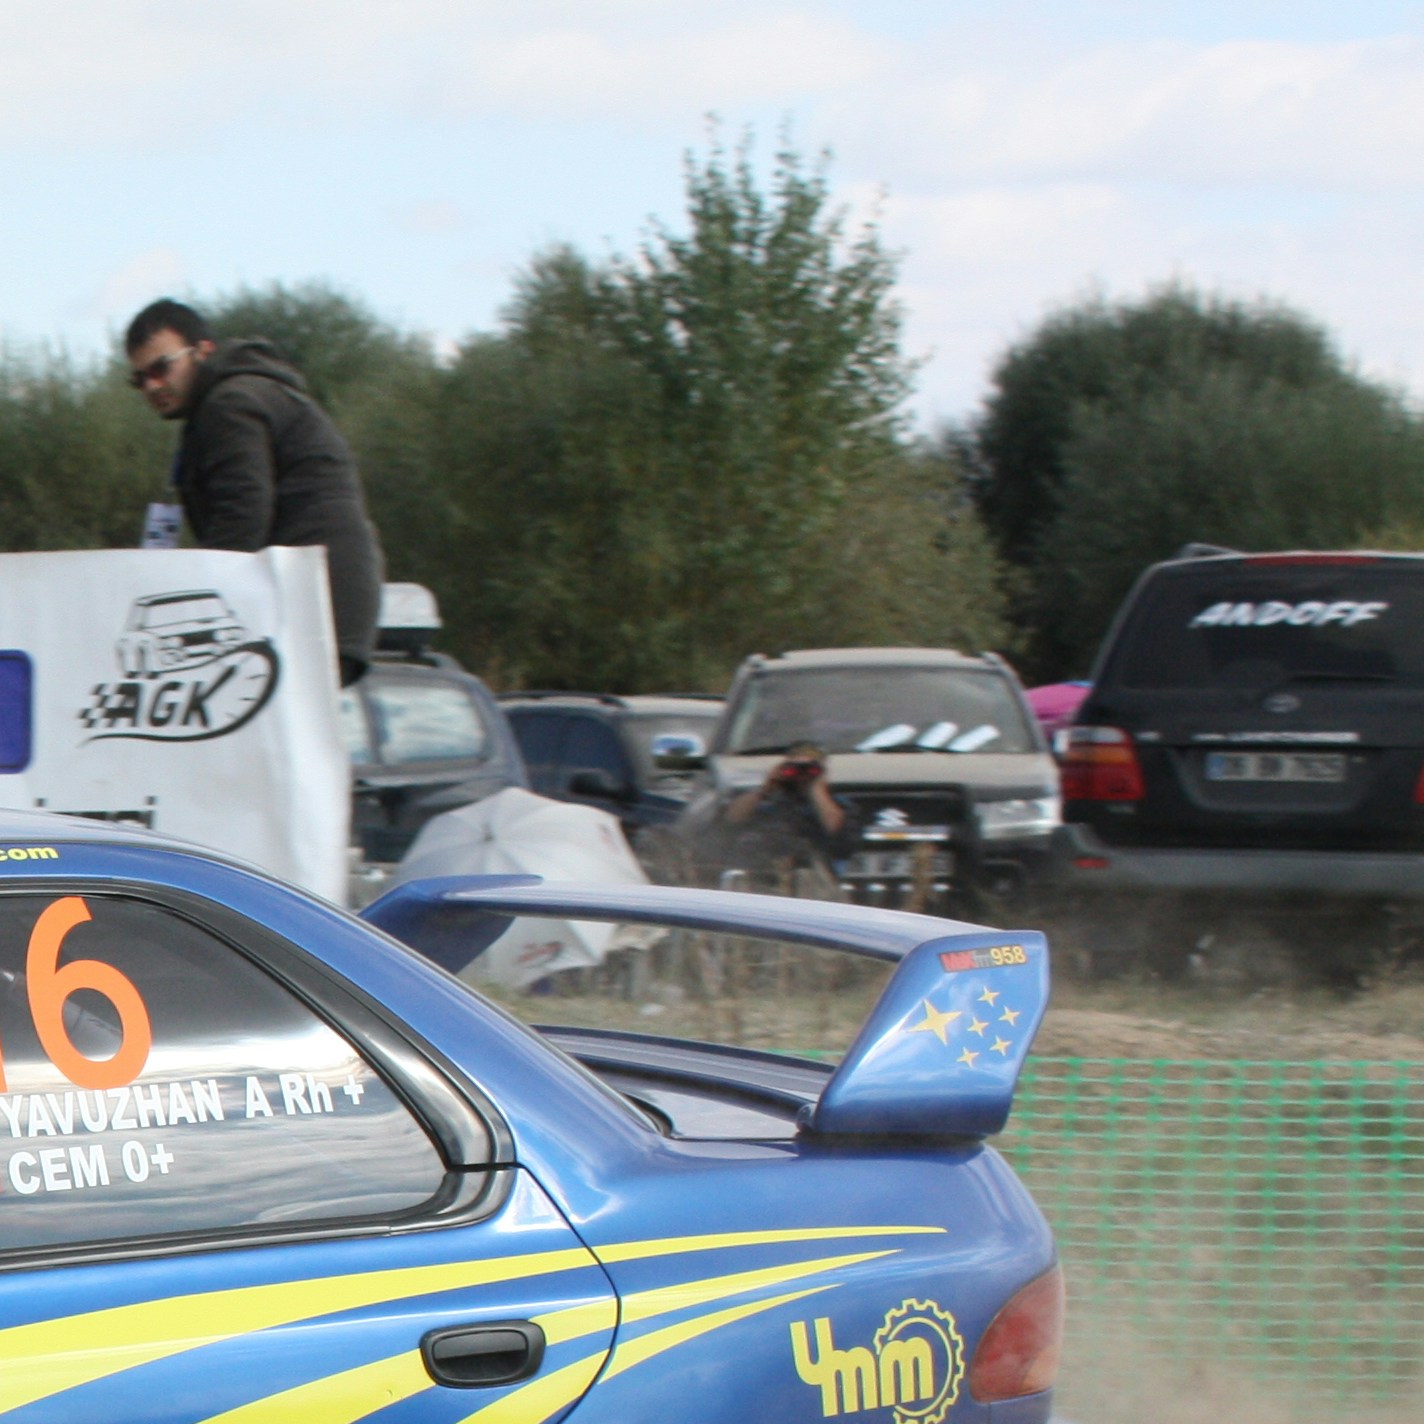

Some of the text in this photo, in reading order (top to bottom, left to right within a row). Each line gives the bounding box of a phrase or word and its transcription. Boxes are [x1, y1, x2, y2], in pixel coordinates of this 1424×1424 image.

[100, 664, 236, 729] AGK
[245, 1075, 274, 1119] A
[278, 1071, 334, 1117] Rh
[8, 1144, 111, 1196] CEM
